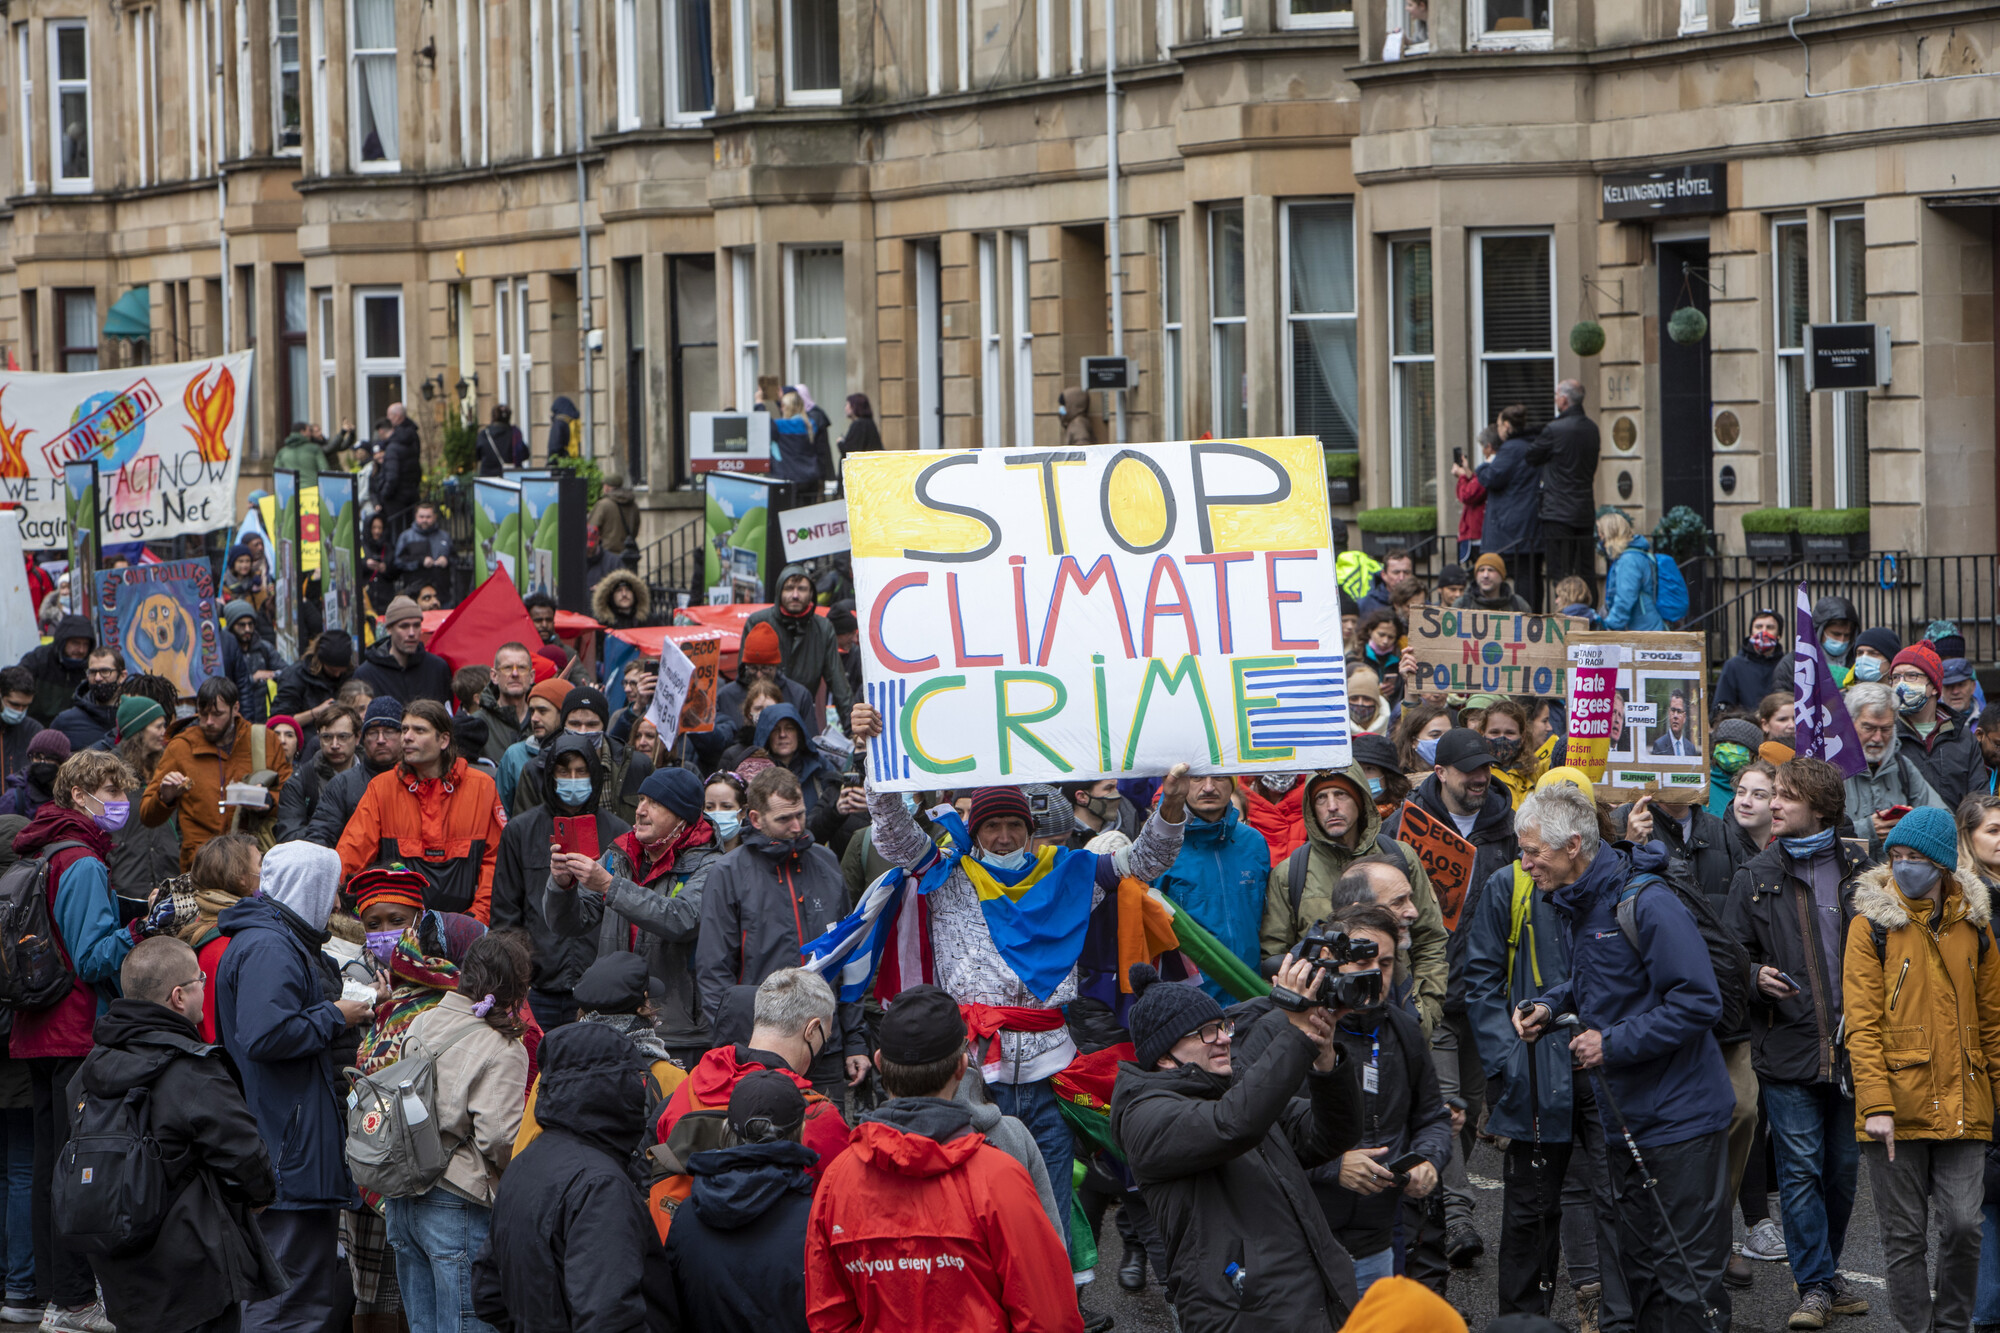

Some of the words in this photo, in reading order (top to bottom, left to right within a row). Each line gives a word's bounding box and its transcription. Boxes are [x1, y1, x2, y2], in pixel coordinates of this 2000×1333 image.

[1603, 181, 1675, 203] KELVINGROVE
[1676, 178, 1713, 197] HOTEL
[1817, 347, 1870, 356] KELVINGROVE
[50, 418, 108, 469] CODE
[107, 389, 153, 432] RED
[1, 472, 39, 501] WE
[116, 455, 159, 495] ACT
[158, 448, 231, 489] NOW
[717, 460, 745, 470] SOLD
[903, 442, 1292, 563] STOP
[828, 520, 848, 537] LET
[123, 569, 147, 586] OUT
[150, 564, 214, 598] POLLUTERS
[199, 601, 213, 620] OF
[1418, 607, 1570, 644] SOLUTION
[1463, 640, 1526, 665] NOT
[1641, 652, 1683, 660] FOOLS
[1620, 772, 1656, 781] BURNING
[1671, 775, 1701, 783] THINGS
[864, 1258, 894, 1277] you
[898, 1257, 932, 1275] every
[935, 1252, 965, 1271] step
